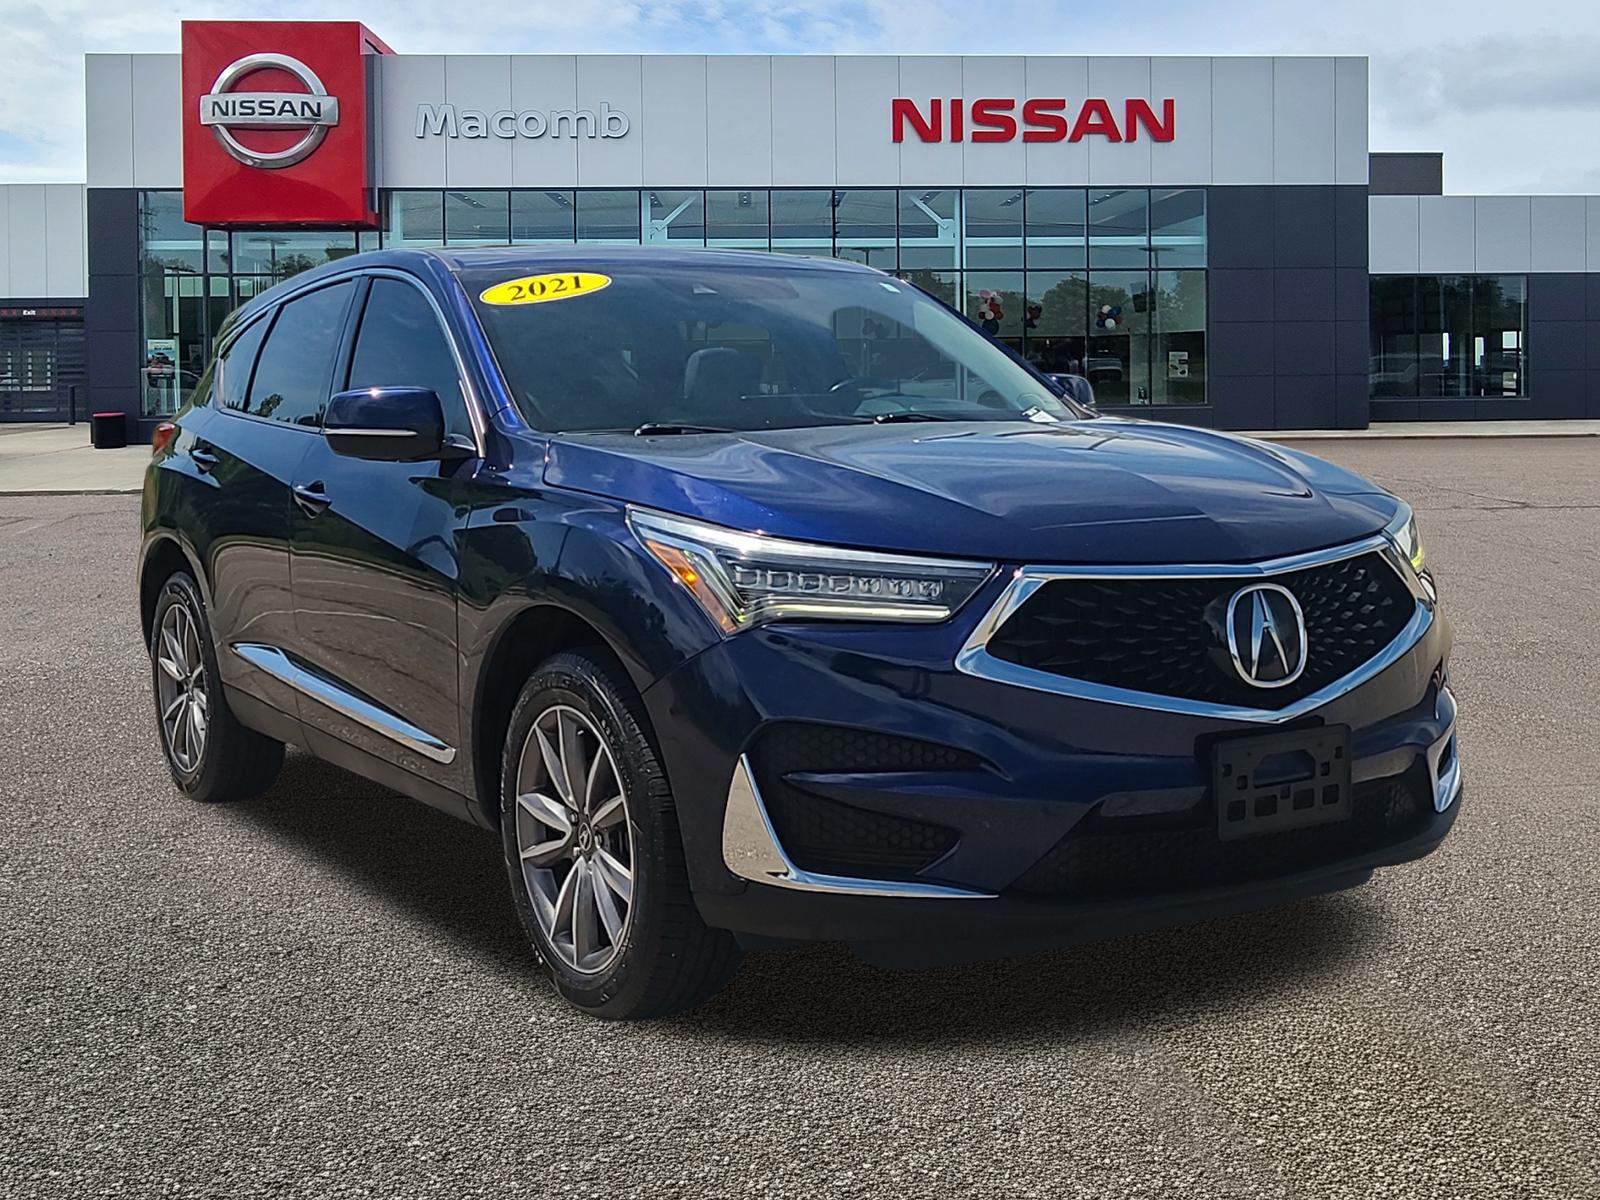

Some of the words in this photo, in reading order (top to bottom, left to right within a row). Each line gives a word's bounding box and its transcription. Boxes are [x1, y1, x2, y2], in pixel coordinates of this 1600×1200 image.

[212, 100, 322, 117] NISSAN
[415, 102, 630, 139] Macomb
[891, 98, 1175, 143] NISSAN
[508, 276, 581, 300] 2021
